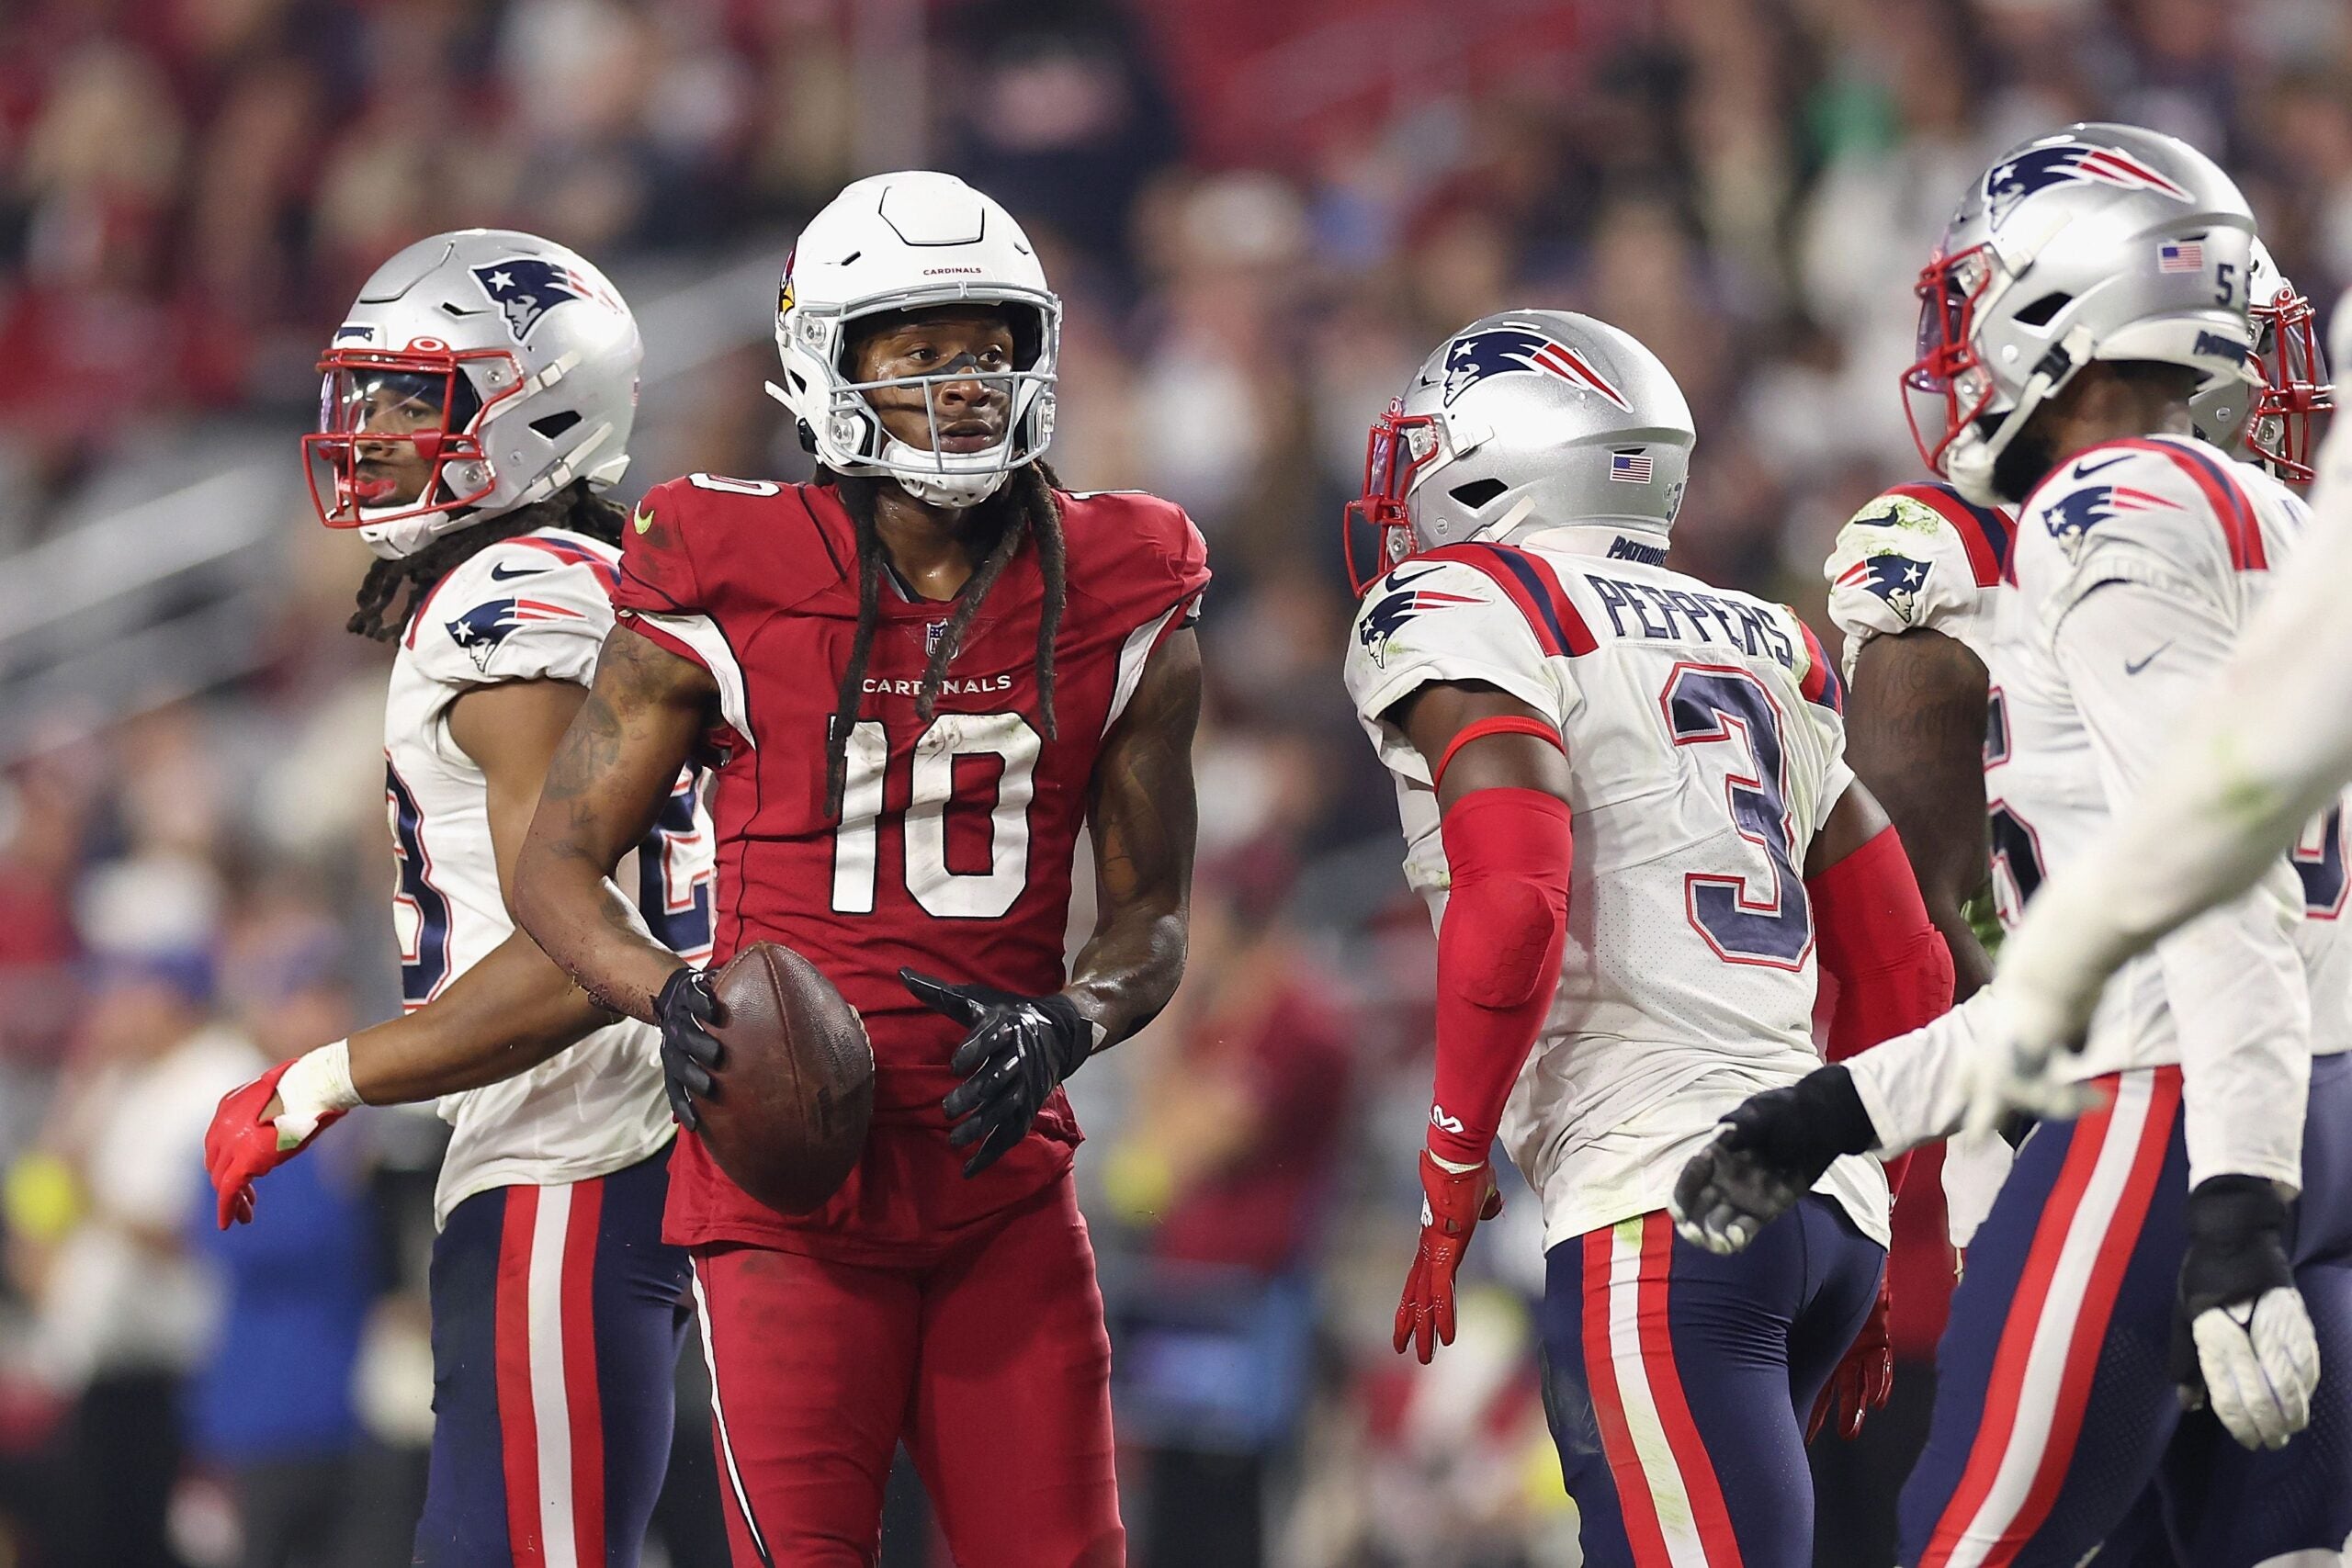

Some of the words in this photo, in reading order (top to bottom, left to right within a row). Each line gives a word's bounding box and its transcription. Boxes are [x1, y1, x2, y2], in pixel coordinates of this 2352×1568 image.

[922, 266, 982, 276] CARDINALS
[1583, 573, 1793, 671] PEPPERS
[829, 711, 1043, 919] 10
[1659, 661, 1815, 974] 3
